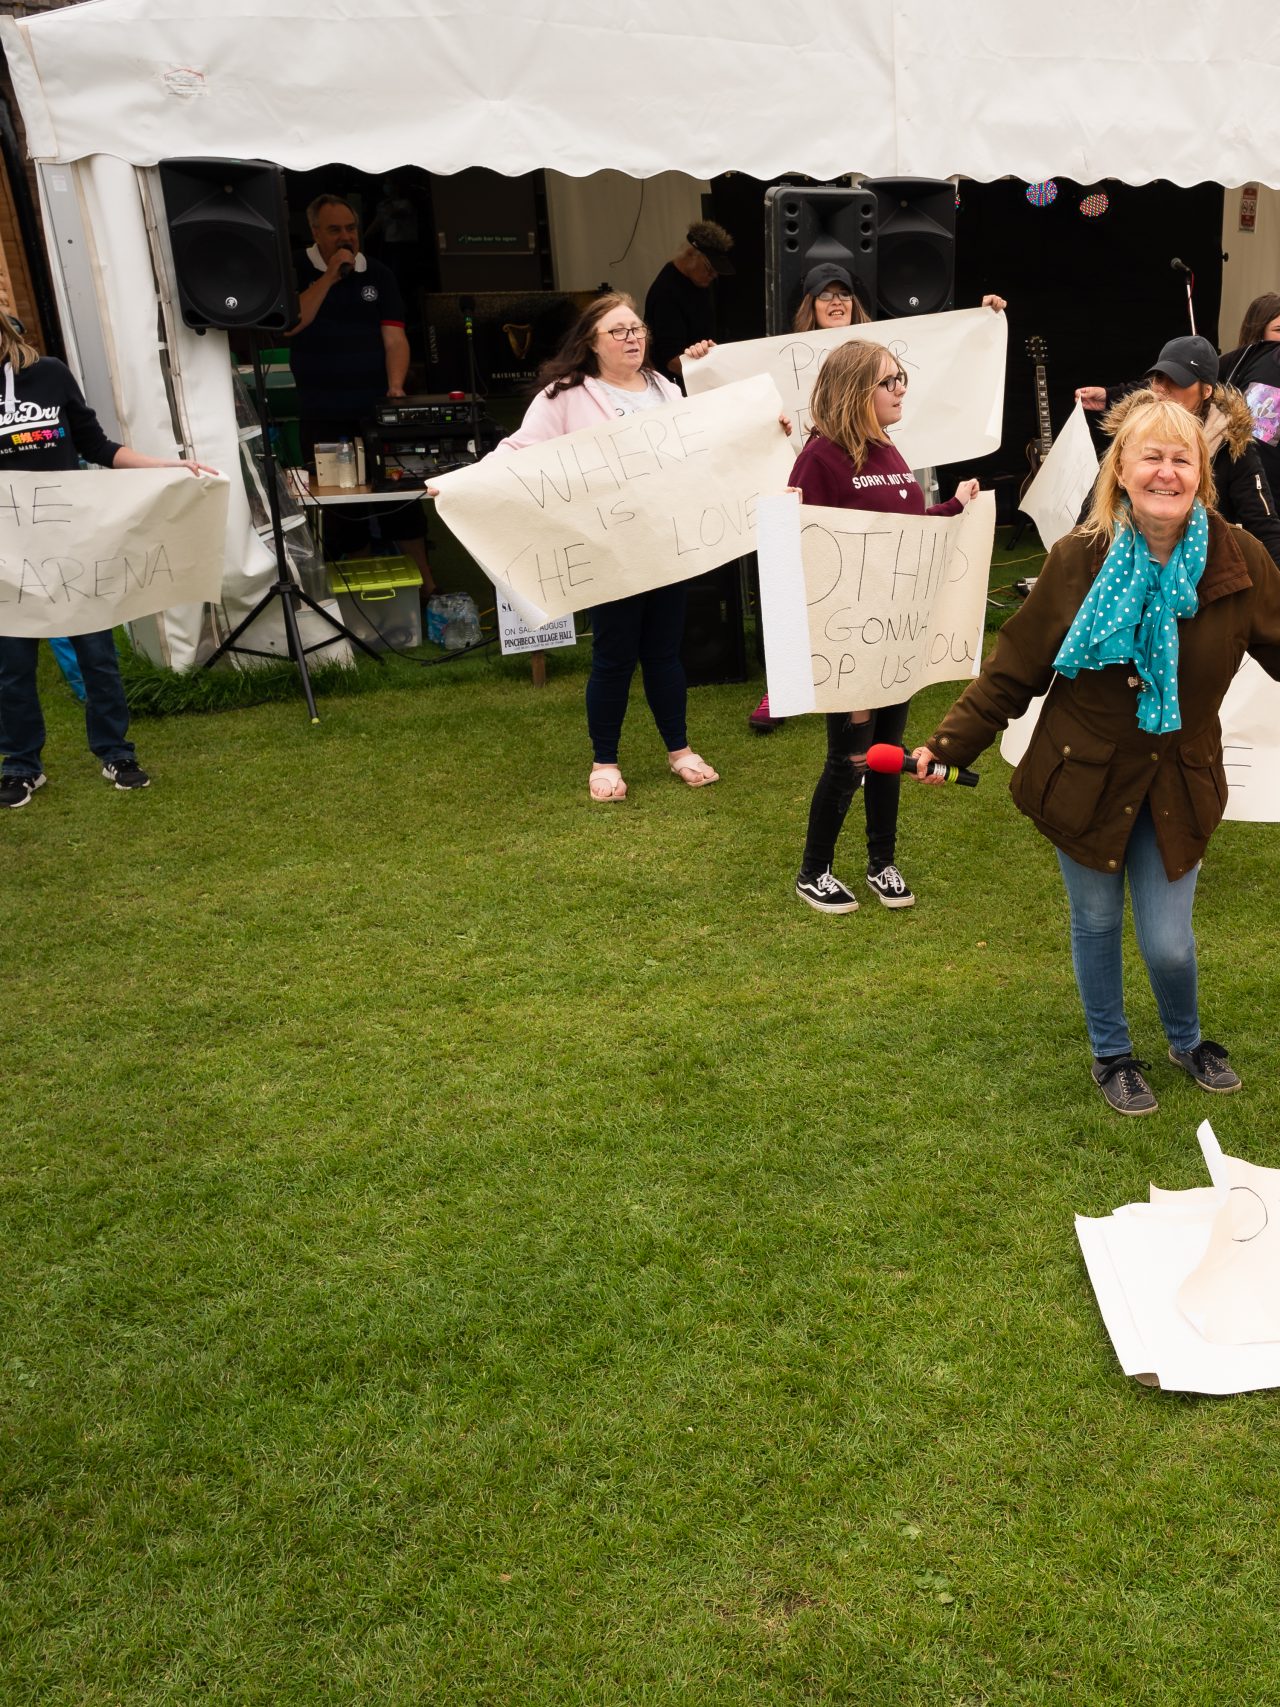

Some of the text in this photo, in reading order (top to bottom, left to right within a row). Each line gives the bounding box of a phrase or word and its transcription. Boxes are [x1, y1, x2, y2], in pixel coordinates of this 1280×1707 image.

[506, 411, 709, 509] WHERE
[887, 473, 905, 486] NOT
[596, 500, 635, 530] IS
[501, 492, 760, 603] THE LOVE
[504, 627, 516, 636] ON
[539, 620, 568, 632] AUGUST
[504, 635, 537, 648] PINCHBECK
[536, 632, 559, 643] VILLAGE
[558, 630, 573, 640] HALL
[880, 655, 916, 689] US
